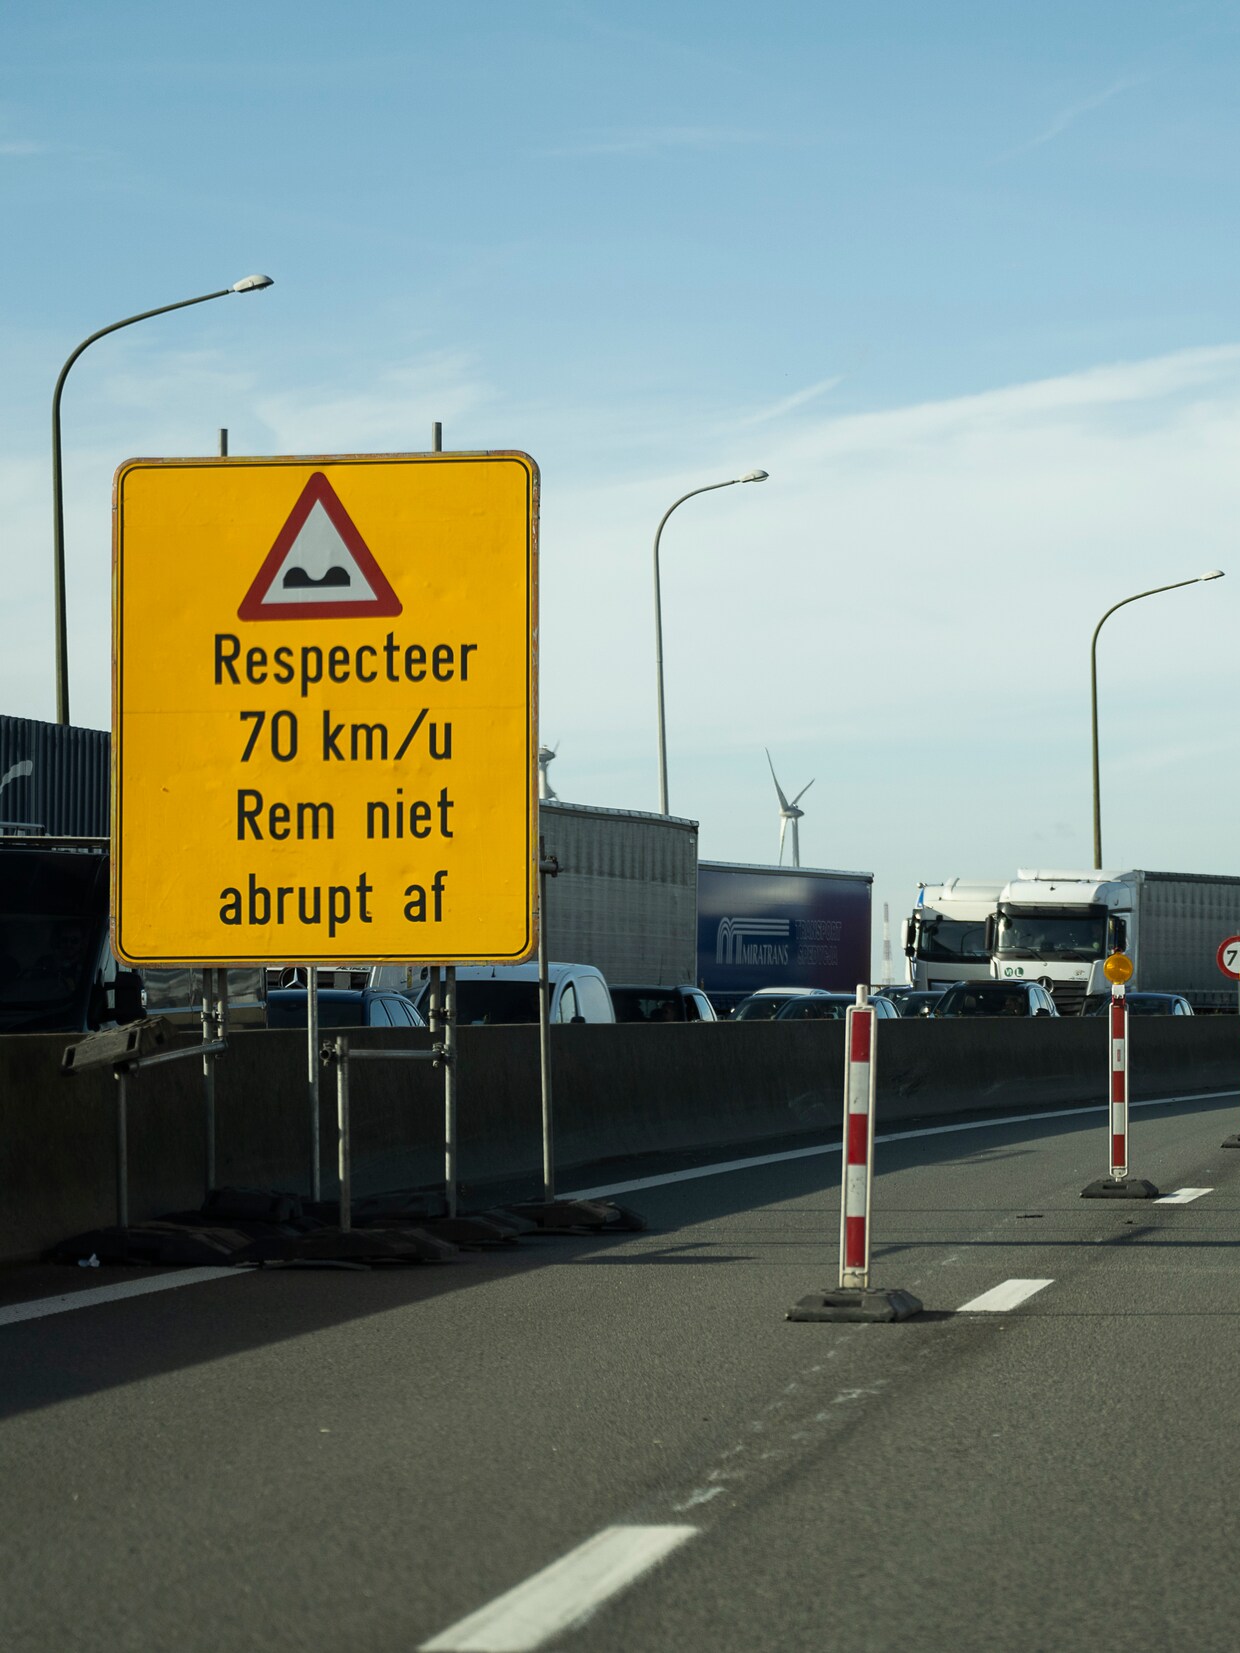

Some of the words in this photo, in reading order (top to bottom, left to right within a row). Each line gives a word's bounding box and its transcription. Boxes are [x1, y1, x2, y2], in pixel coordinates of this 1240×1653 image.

[214, 632, 478, 697] Respecteer
[240, 710, 298, 763] 70
[322, 708, 453, 762] km/u
[237, 788, 335, 841] Rem
[367, 787, 455, 840] niet
[219, 872, 373, 938] abrupt
[402, 870, 449, 923] af
[742, 943, 789, 966] MIRATRANS
